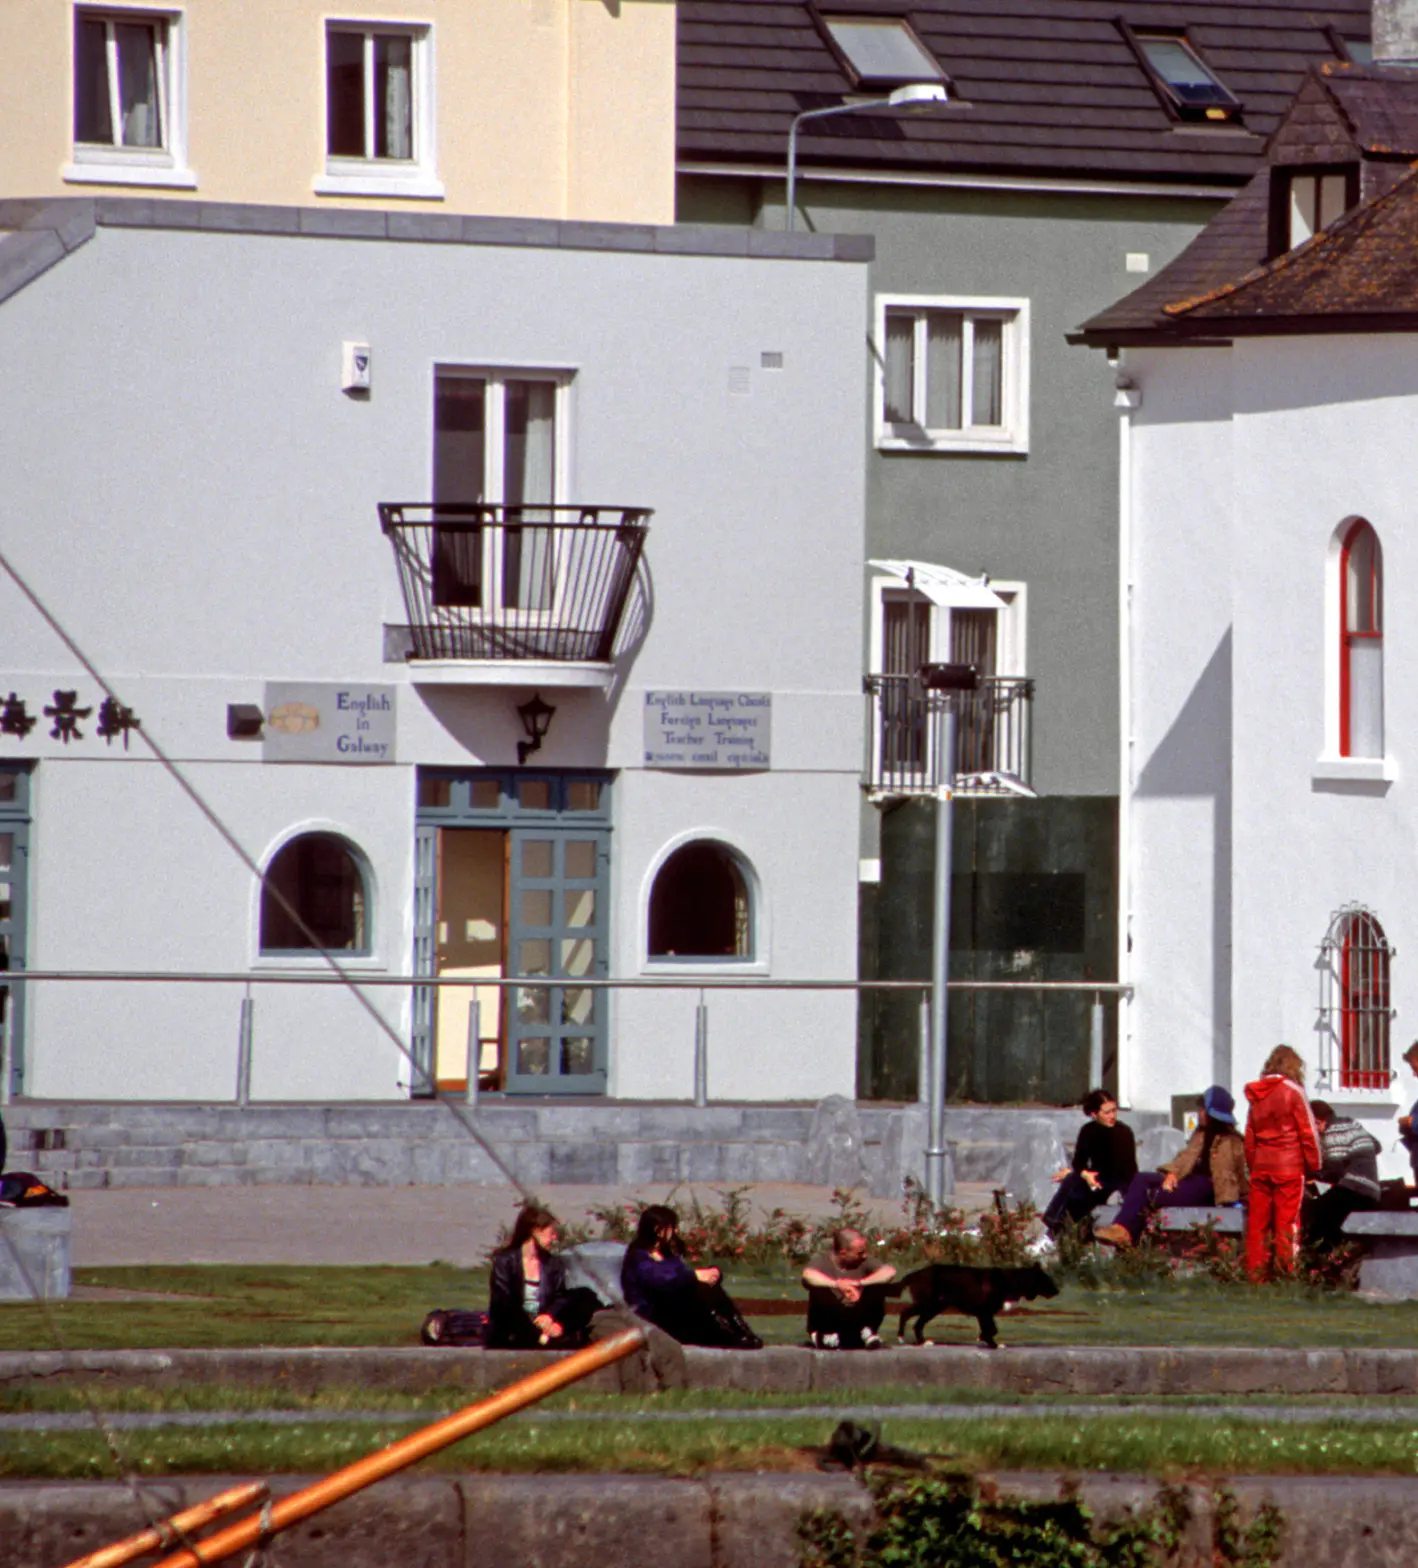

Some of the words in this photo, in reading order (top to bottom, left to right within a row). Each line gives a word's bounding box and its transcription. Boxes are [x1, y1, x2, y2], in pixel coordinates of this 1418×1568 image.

[337, 692, 390, 717] English
[356, 717, 370, 731] in
[337, 734, 388, 759] Galway
